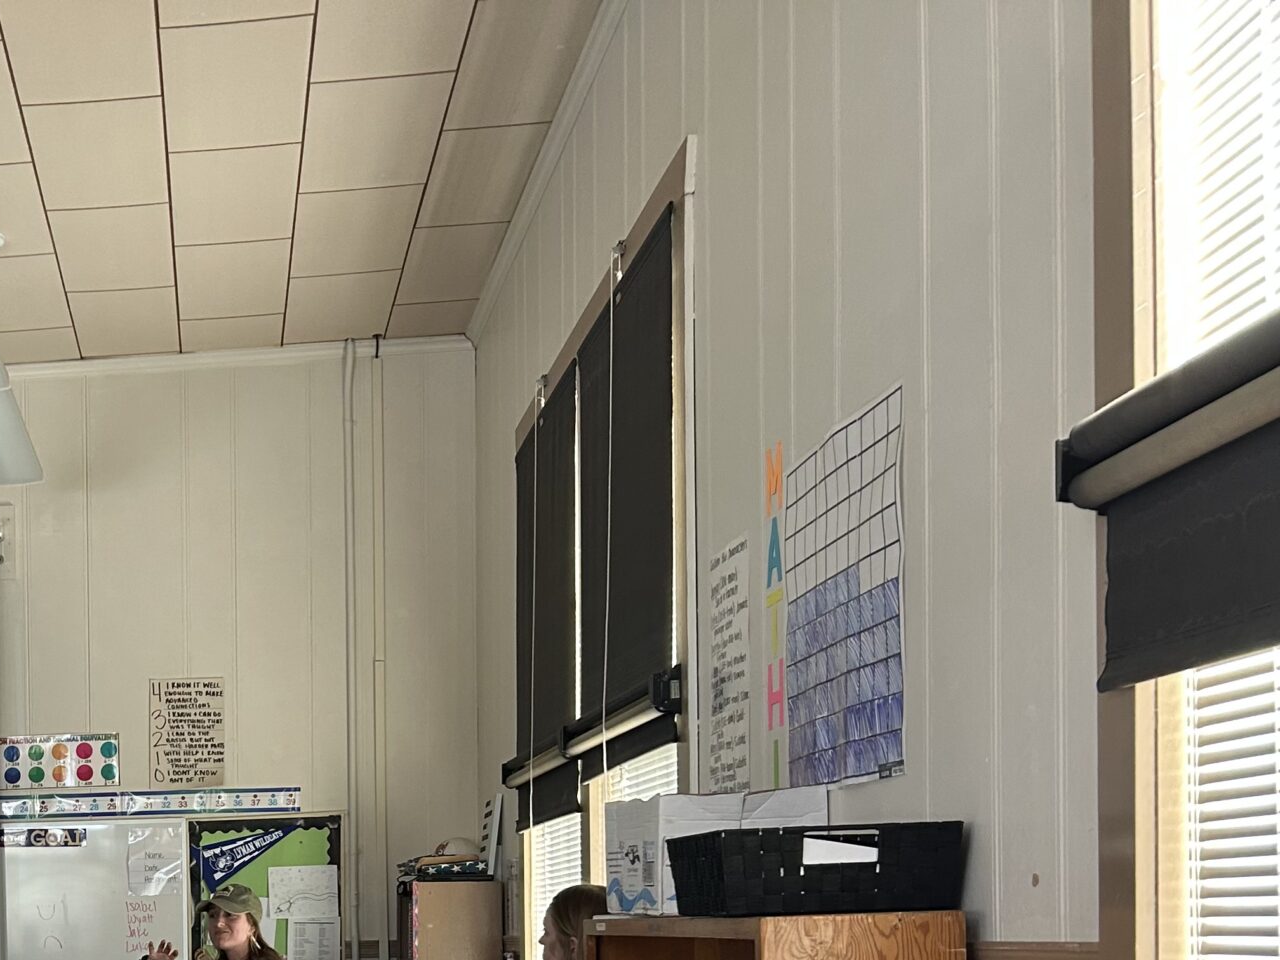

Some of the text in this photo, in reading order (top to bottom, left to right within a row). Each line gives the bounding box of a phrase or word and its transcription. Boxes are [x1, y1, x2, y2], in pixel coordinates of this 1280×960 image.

[152, 682, 162, 702] 4
[152, 710, 166, 730] 3
[152, 732, 168, 747] 2
[233, 830, 283, 858] LYMAN WILDCATS
[126, 901, 157, 912] Isabel
[128, 914, 153, 926] Wyatt
[126, 925, 148, 937] Jake
